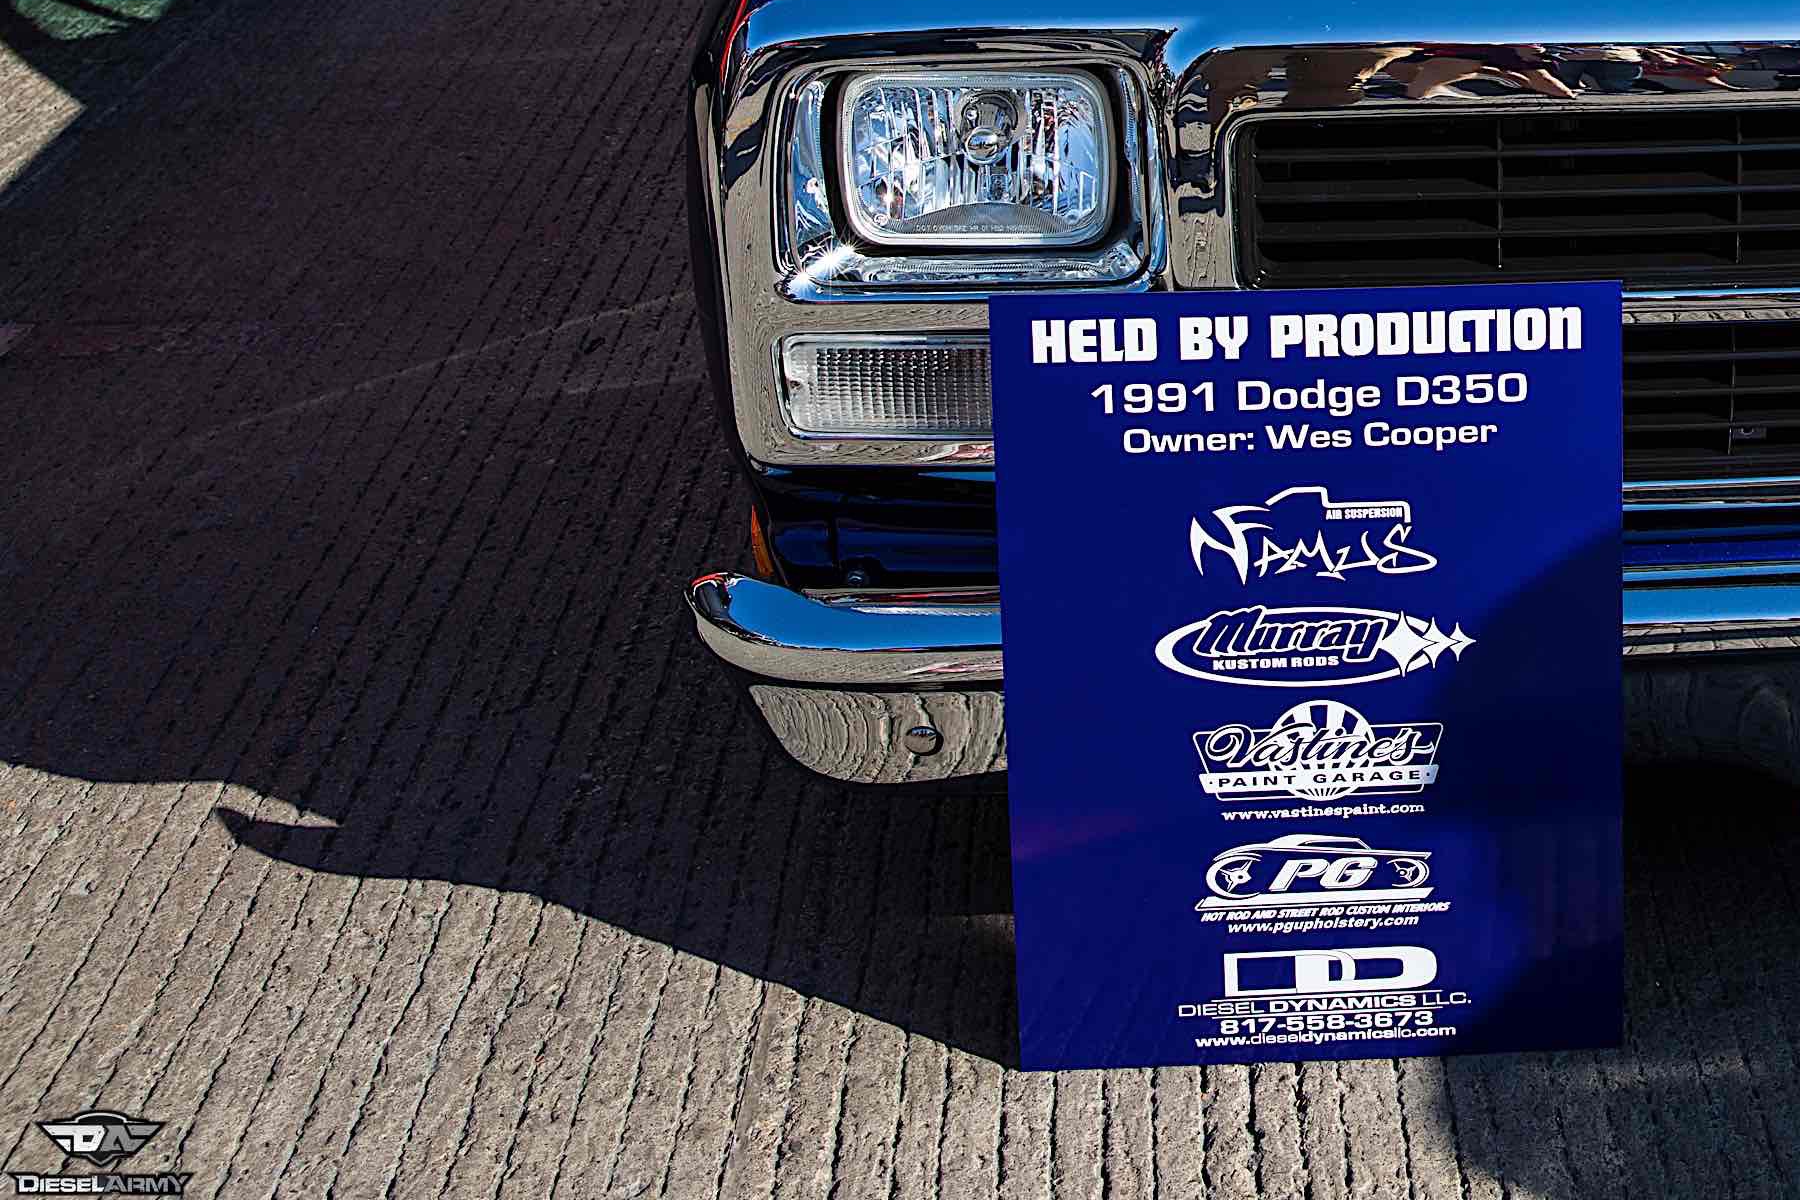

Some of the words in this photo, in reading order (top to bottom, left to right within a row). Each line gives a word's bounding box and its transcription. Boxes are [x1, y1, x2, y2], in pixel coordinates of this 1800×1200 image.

[1031, 317, 1158, 364] HELD
[1179, 315, 1249, 360] BY
[1269, 306, 1583, 359] PRODUCTION
[1090, 382, 1216, 414] 1991
[1237, 378, 1381, 417] Dodge
[1396, 372, 1529, 407] D350
[1122, 427, 1256, 454] Owner:
[1265, 424, 1353, 450] Wes
[1362, 420, 1500, 452] Cooper
[1325, 508, 1343, 521] AIR
[1344, 506, 1404, 519] SUSPENSION
[1192, 604, 1389, 664] Murray
[1212, 657, 1288, 671] KUSTOM
[1290, 655, 1340, 669] RODS
[1205, 722, 1435, 769] Vastine's
[1218, 774, 1297, 788] PAINT
[1312, 770, 1422, 784] GARAGE
[1221, 802, 1426, 822] www.vastinespaint.com
[1267, 856, 1379, 892] PG
[1200, 911, 1226, 922] HOT
[1225, 910, 1252, 921] ROD
[1251, 908, 1277, 920] AND
[1277, 907, 1319, 919] STREET
[1319, 906, 1345, 918] ROD
[1345, 903, 1392, 916] CUSTOM
[1391, 901, 1451, 914] INTERIORS
[1227, 914, 1420, 934] www.pgupholstery.com
[1177, 1002, 1266, 1018] DIESEL
[1268, 994, 1417, 1013] DYNAMICS
[1420, 991, 1473, 1007] LLC.
[1219, 1011, 1434, 1035] 817-558-3673
[1194, 1025, 1457, 1048] www.dieseldynamicsllc.com
